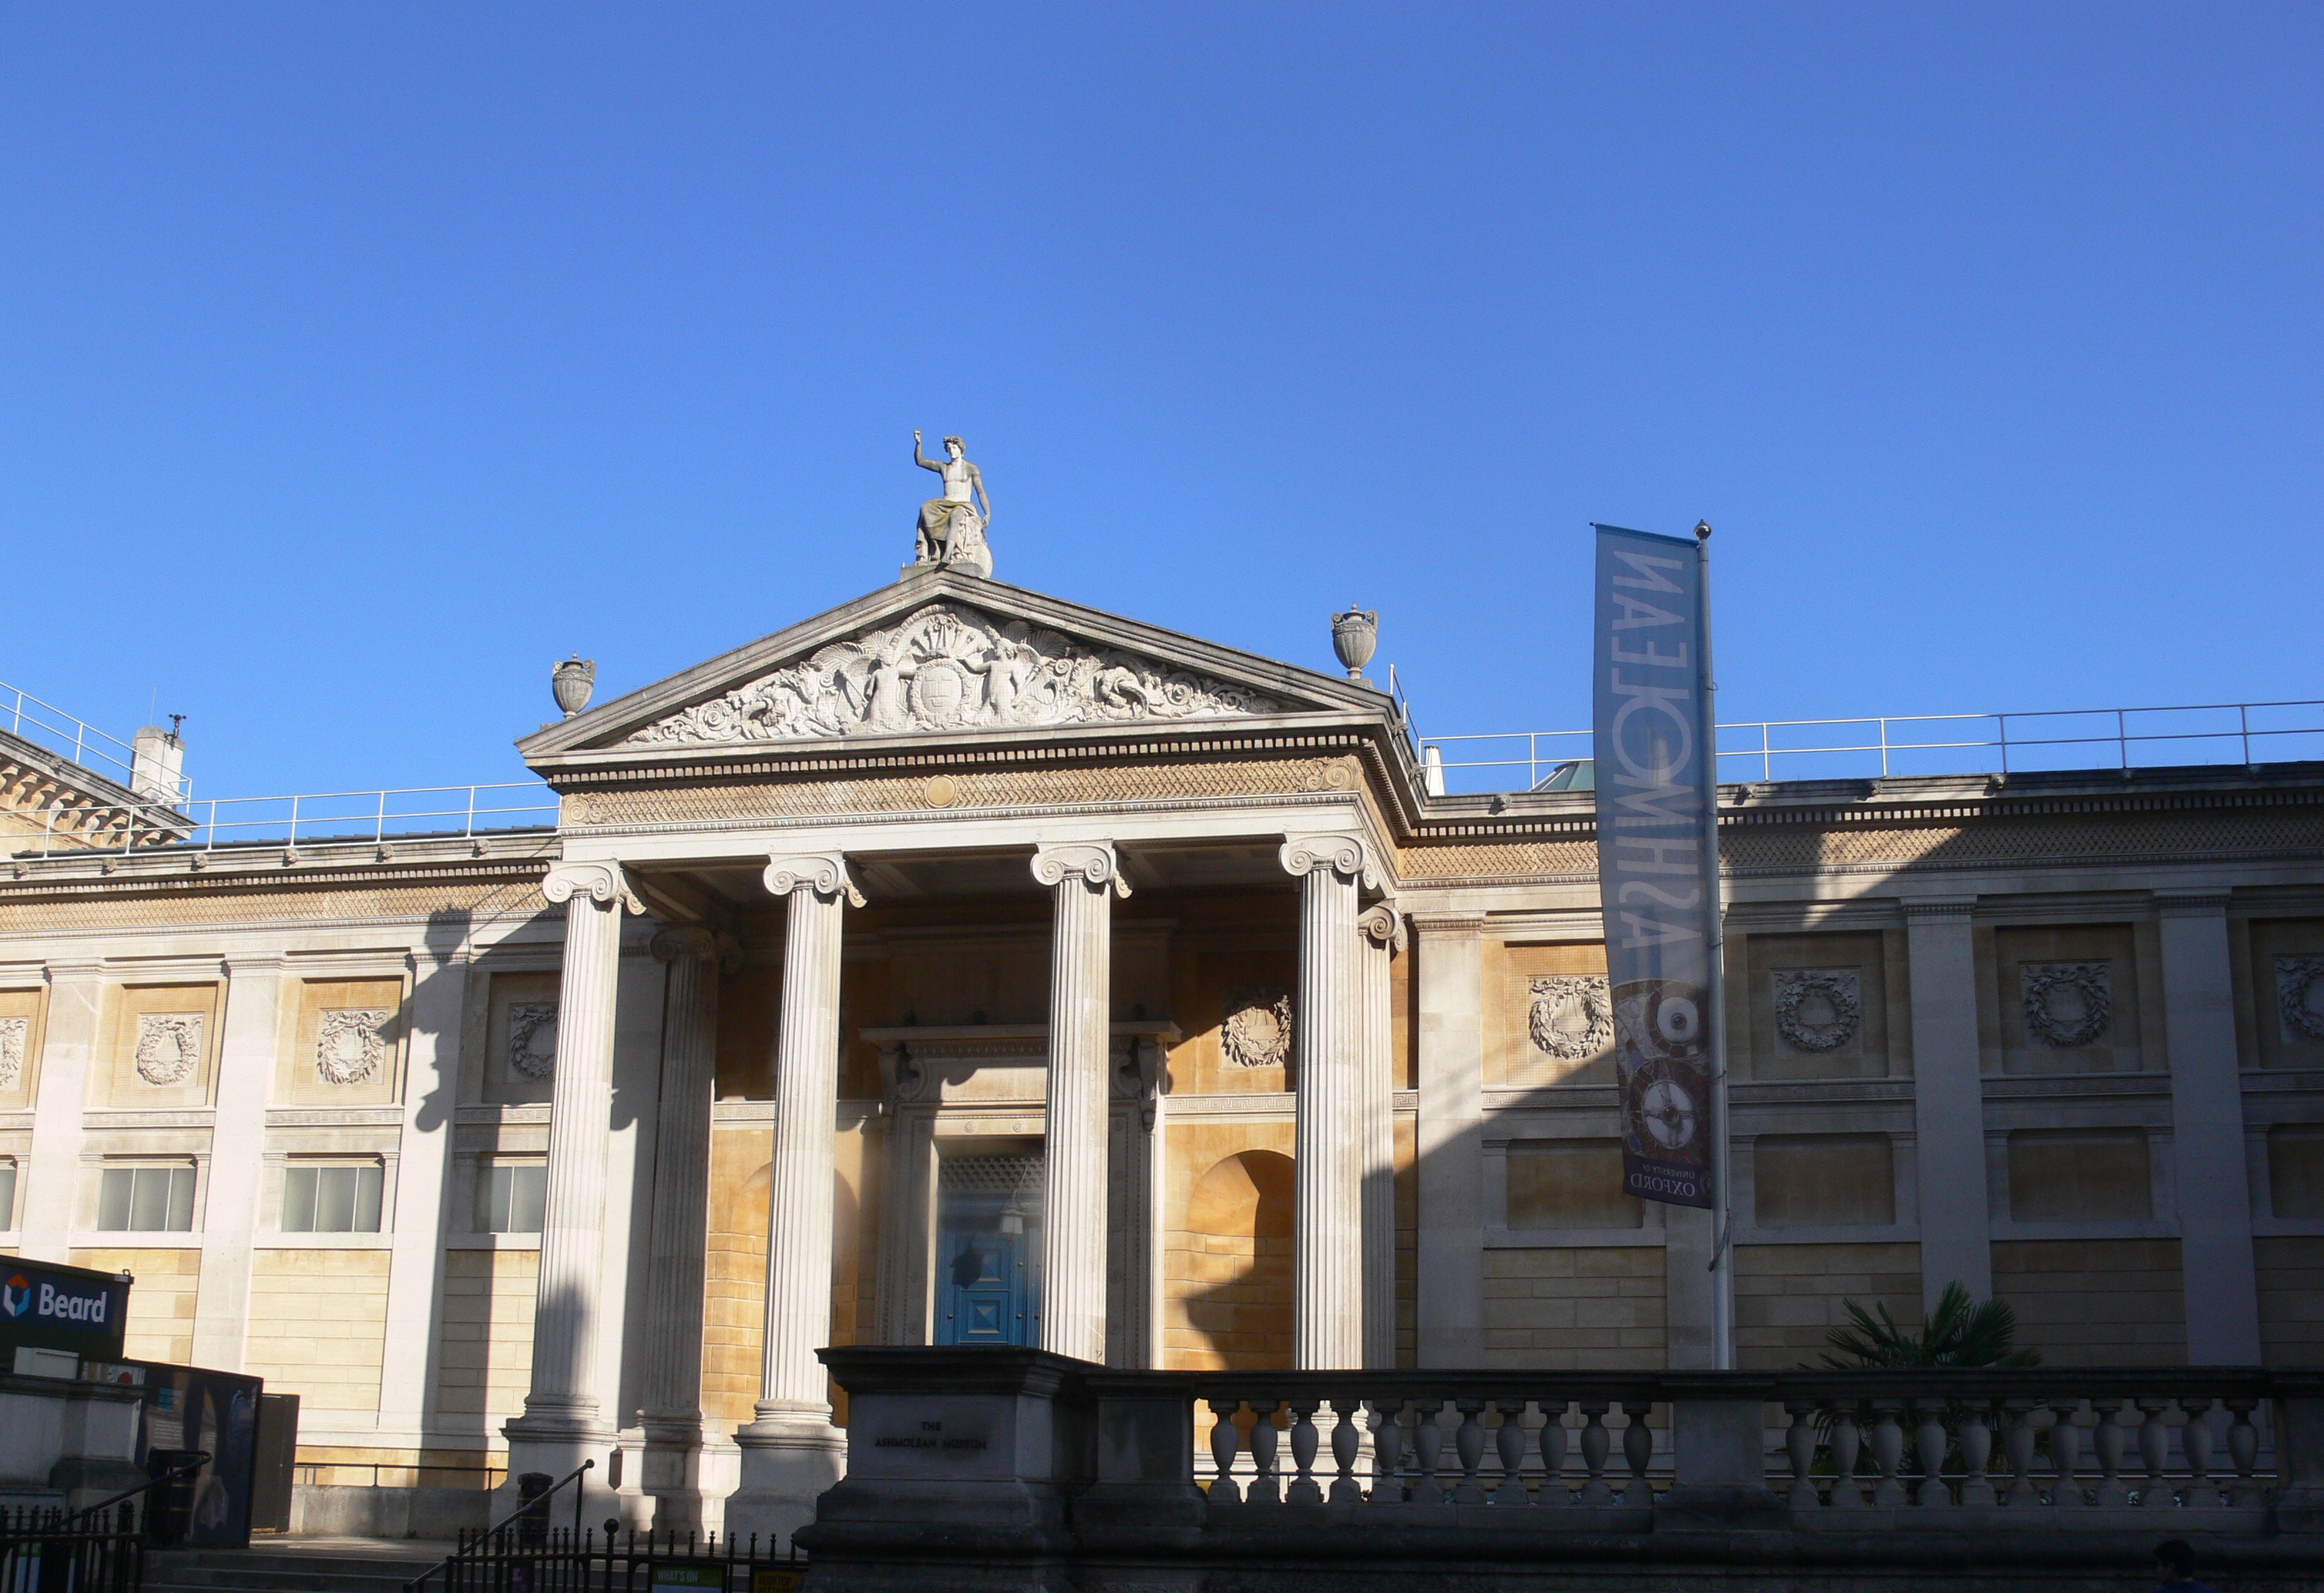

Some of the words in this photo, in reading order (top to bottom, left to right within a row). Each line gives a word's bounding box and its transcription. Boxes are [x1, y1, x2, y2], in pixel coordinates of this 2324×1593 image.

[38, 1283, 107, 1323] Beard
[921, 1421, 941, 1431] THE
[874, 1437, 937, 1448] ASHMOLEAN
[943, 1439, 987, 1449] MUSEUM
[657, 1569, 685, 1582] WHAT'S
[686, 1570, 698, 1582] ON
